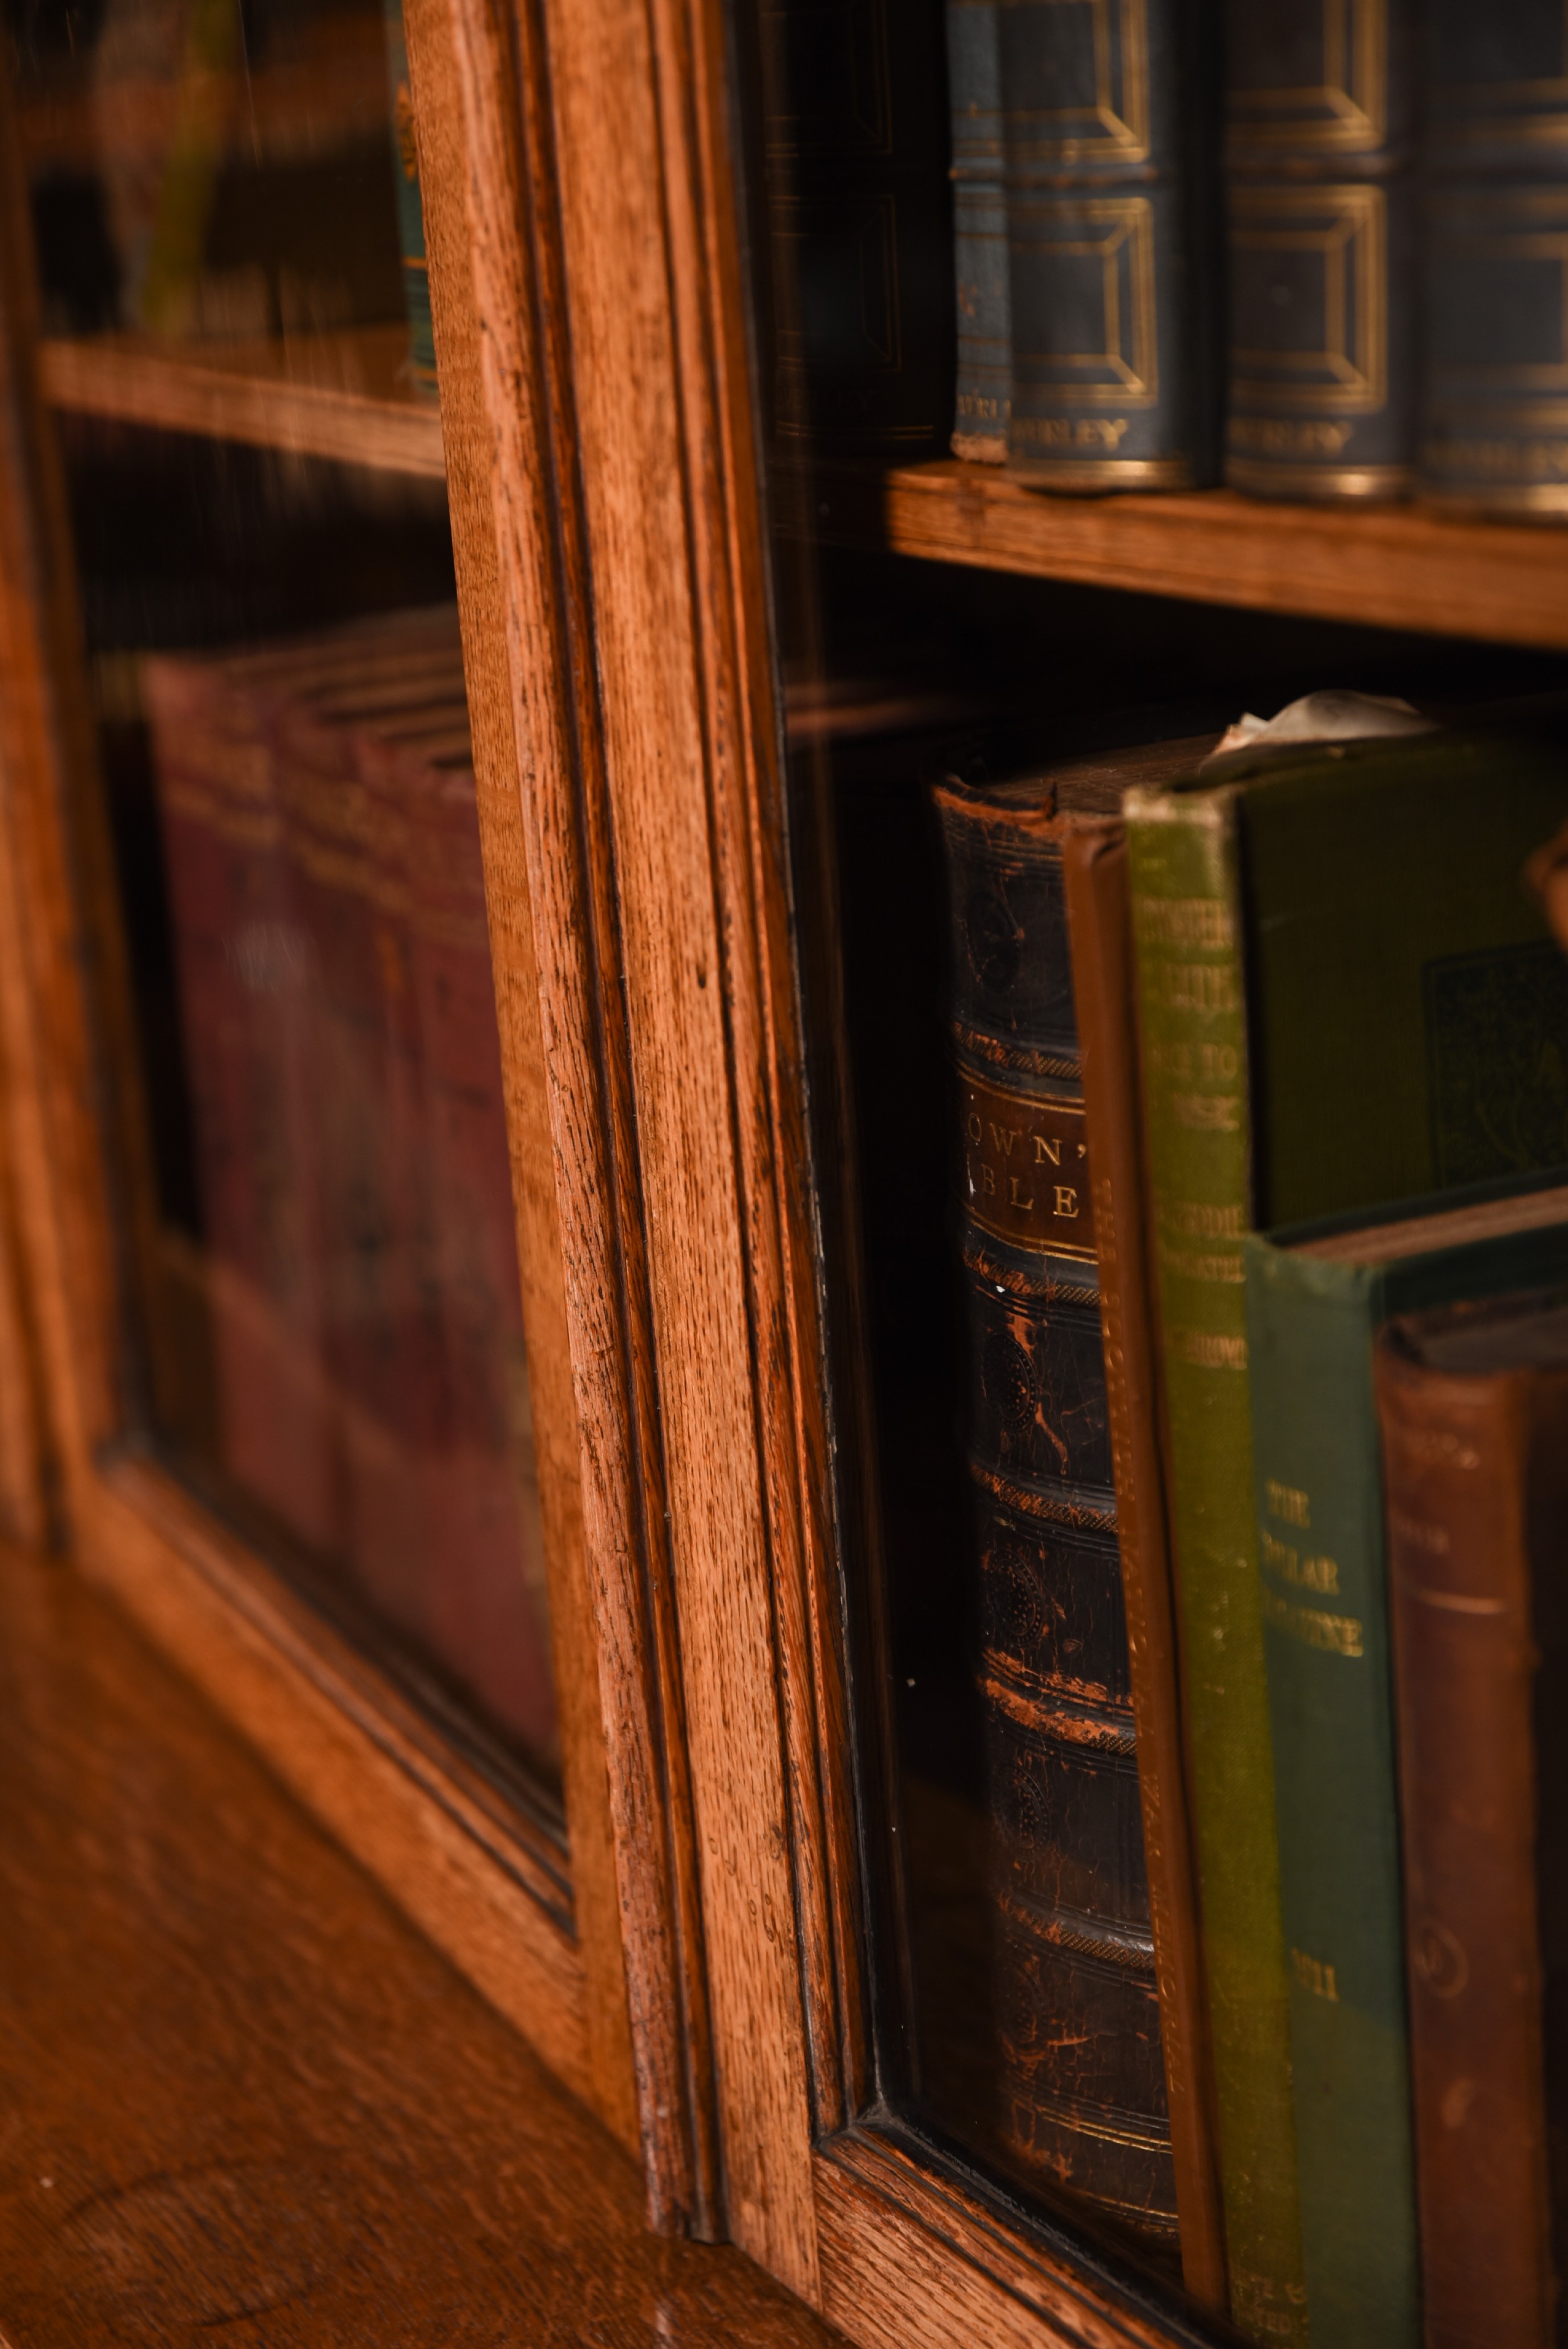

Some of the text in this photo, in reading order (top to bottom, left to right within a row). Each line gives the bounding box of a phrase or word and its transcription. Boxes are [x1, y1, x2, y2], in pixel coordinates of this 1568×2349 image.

[1093, 1177, 1185, 2094] THE SCOTTISH NATIONAL WAR MEMORIAL
